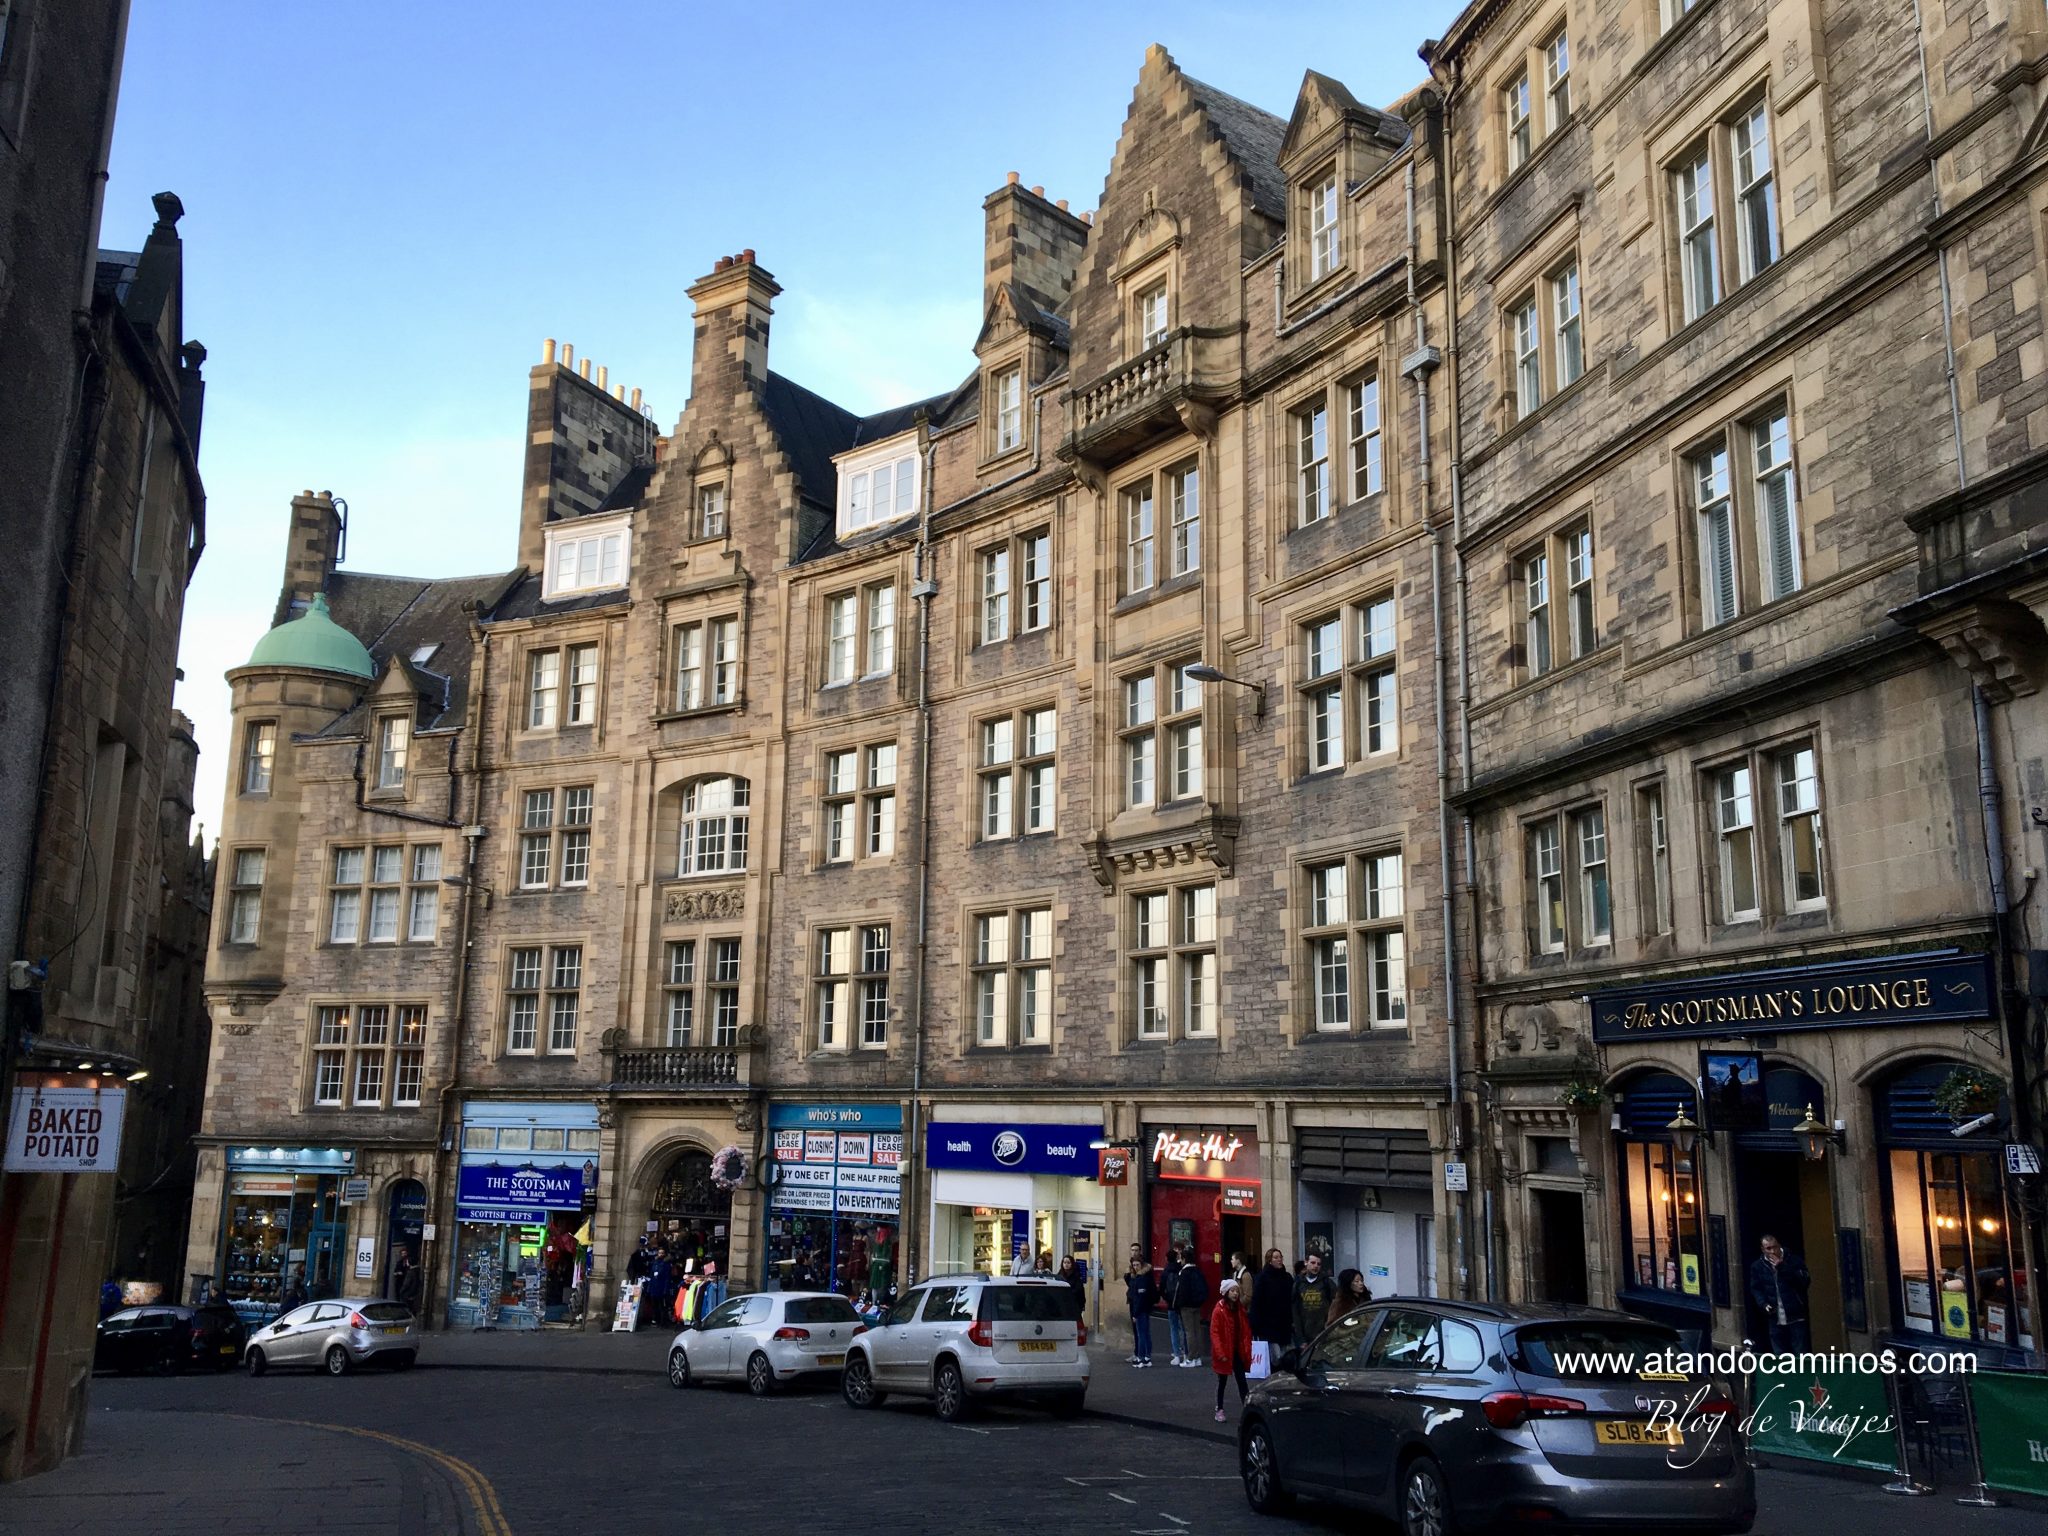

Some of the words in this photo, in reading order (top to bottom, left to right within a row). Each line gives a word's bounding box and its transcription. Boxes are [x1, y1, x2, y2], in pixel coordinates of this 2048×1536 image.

[1624, 1003, 1656, 1029] The
[1660, 989, 1803, 1026] SCOTSMAN'S
[1811, 978, 1931, 1014] LOUNGE
[31, 1098, 46, 1107] THE
[808, 1109, 837, 1121] who's
[840, 1109, 862, 1121] who
[1769, 1103, 1808, 1116] Welcom
[27, 1108, 103, 1134] BAKED
[777, 1140, 799, 1148] LEASE
[877, 1135, 891, 1143] END
[893, 1135, 902, 1143] OF
[24, 1135, 100, 1158] POTATO
[807, 1141, 834, 1154] CLOSING
[843, 1141, 865, 1155] DOWN
[877, 1143, 902, 1152] LEASE
[947, 1140, 972, 1152] health
[1046, 1143, 1077, 1159] beauty
[1152, 1132, 1202, 1162] Pizza
[1202, 1134, 1244, 1162] Hut
[777, 1150, 799, 1160] SALE
[876, 1152, 902, 1164] SALE
[78, 1159, 97, 1167] SHOP
[1103, 1157, 1126, 1168] Pizza
[776, 1169, 792, 1179] BUY
[794, 1170, 811, 1180] ONE
[813, 1171, 830, 1181] GET
[840, 1173, 855, 1182] ONE
[857, 1174, 876, 1183] HALF
[878, 1175, 901, 1184] PRICE
[1106, 1169, 1123, 1178] Hut
[486, 1177, 509, 1189] THE
[511, 1178, 571, 1191] SCOTSMAN
[1227, 1189, 1240, 1197] COME
[838, 1195, 850, 1207] ON
[851, 1195, 900, 1211] EVERYTHING
[1231, 1199, 1243, 1207] YOUR
[470, 1210, 506, 1219] SCOTTISH
[510, 1212, 532, 1220] GIFTS
[358, 1252, 372, 1262] 65
[1605, 1424, 1640, 1441] SL18
